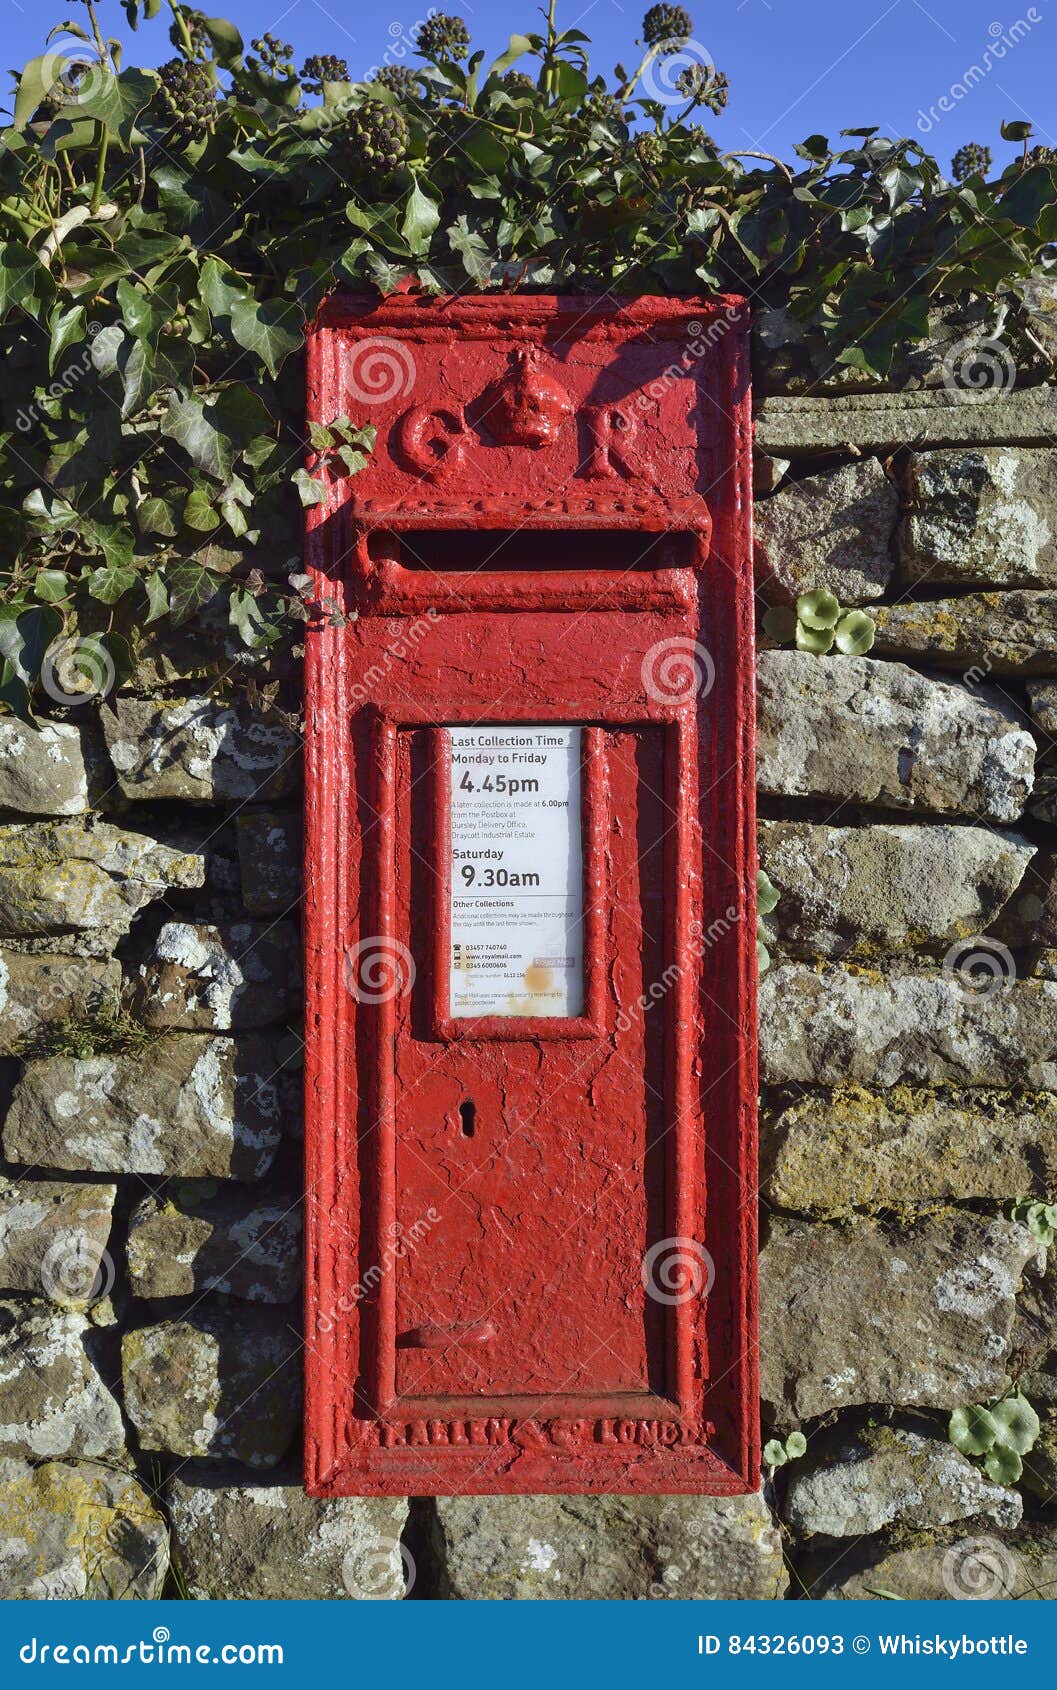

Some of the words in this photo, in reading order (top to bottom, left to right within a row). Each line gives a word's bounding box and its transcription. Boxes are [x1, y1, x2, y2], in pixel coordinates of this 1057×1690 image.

[451, 736, 475, 747] Last
[478, 735, 533, 746] Collection
[535, 735, 564, 746] Time
[452, 753, 495, 765] Monday
[498, 754, 509, 763] to
[512, 752, 547, 765] Friday
[459, 770, 539, 796] 4.45pm
[541, 800, 569, 808] 6.00pm
[479, 820, 505, 829] Delivery
[451, 832, 480, 840] Draycott
[481, 831, 513, 839] Industrial
[452, 848, 504, 861] Saturday
[460, 864, 540, 887] 9.30am
